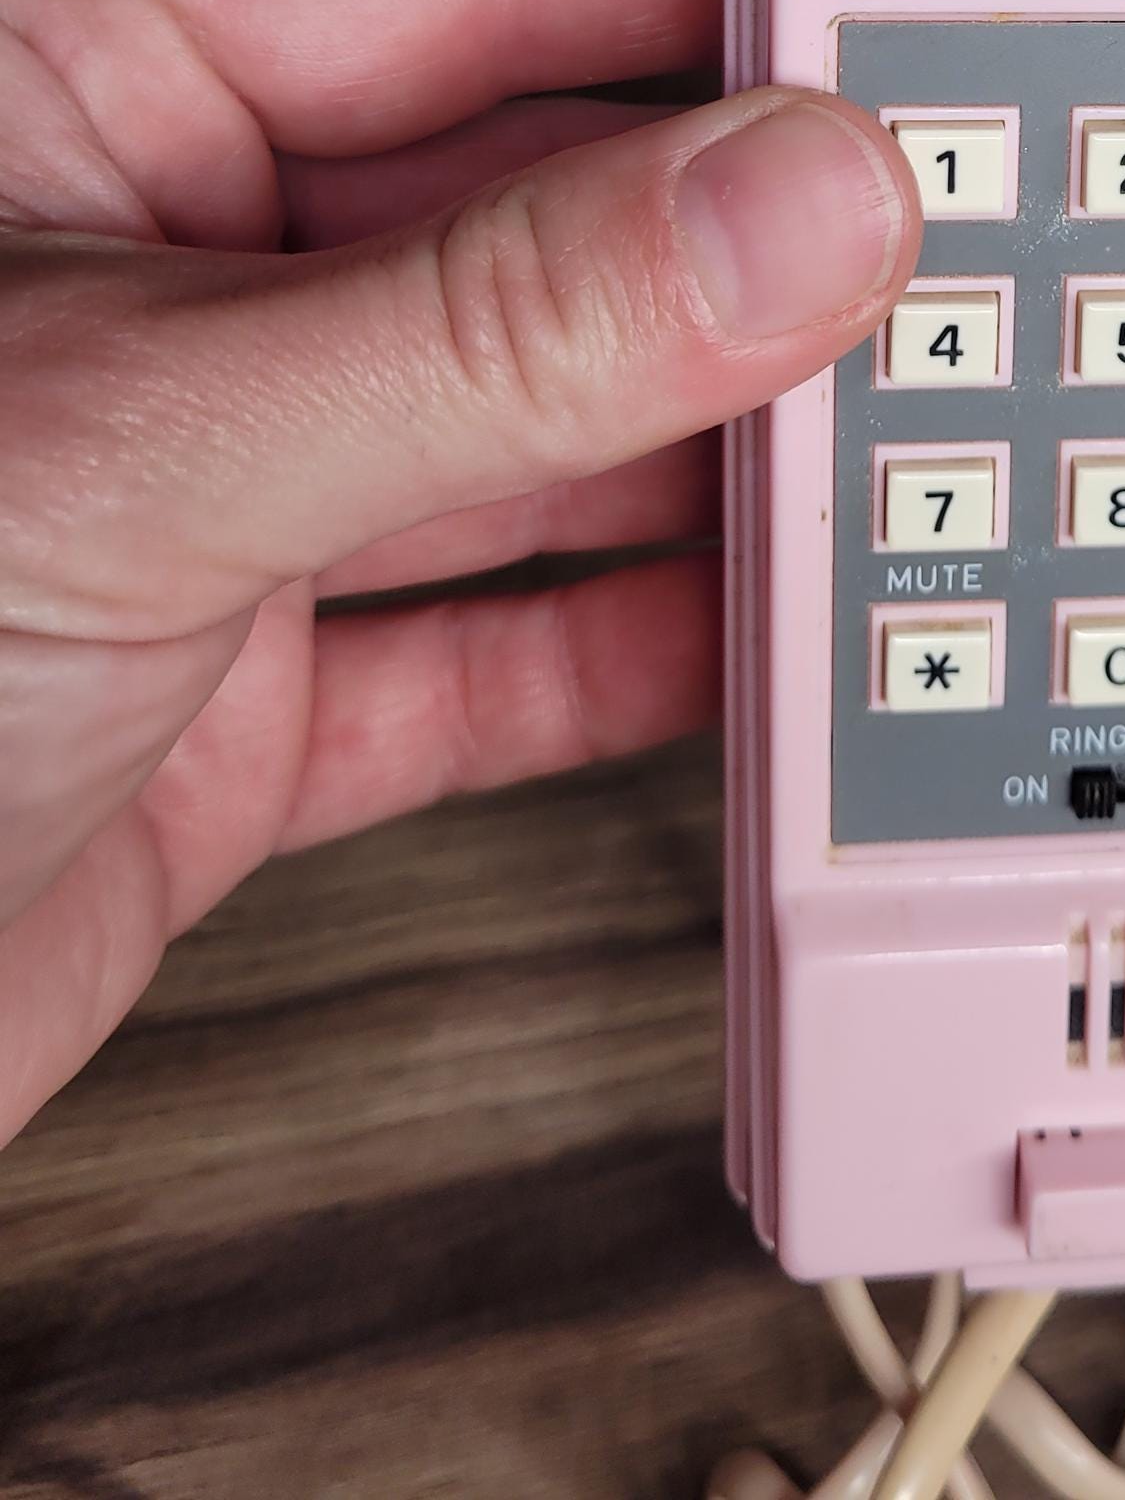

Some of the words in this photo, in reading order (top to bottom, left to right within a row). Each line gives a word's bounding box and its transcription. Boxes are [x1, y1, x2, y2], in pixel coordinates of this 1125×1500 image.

[935, 150, 957, 195] 1
[928, 323, 965, 368] 4
[924, 490, 955, 534] 7
[887, 562, 984, 594] MUTE
[1003, 774, 1049, 806] ON
